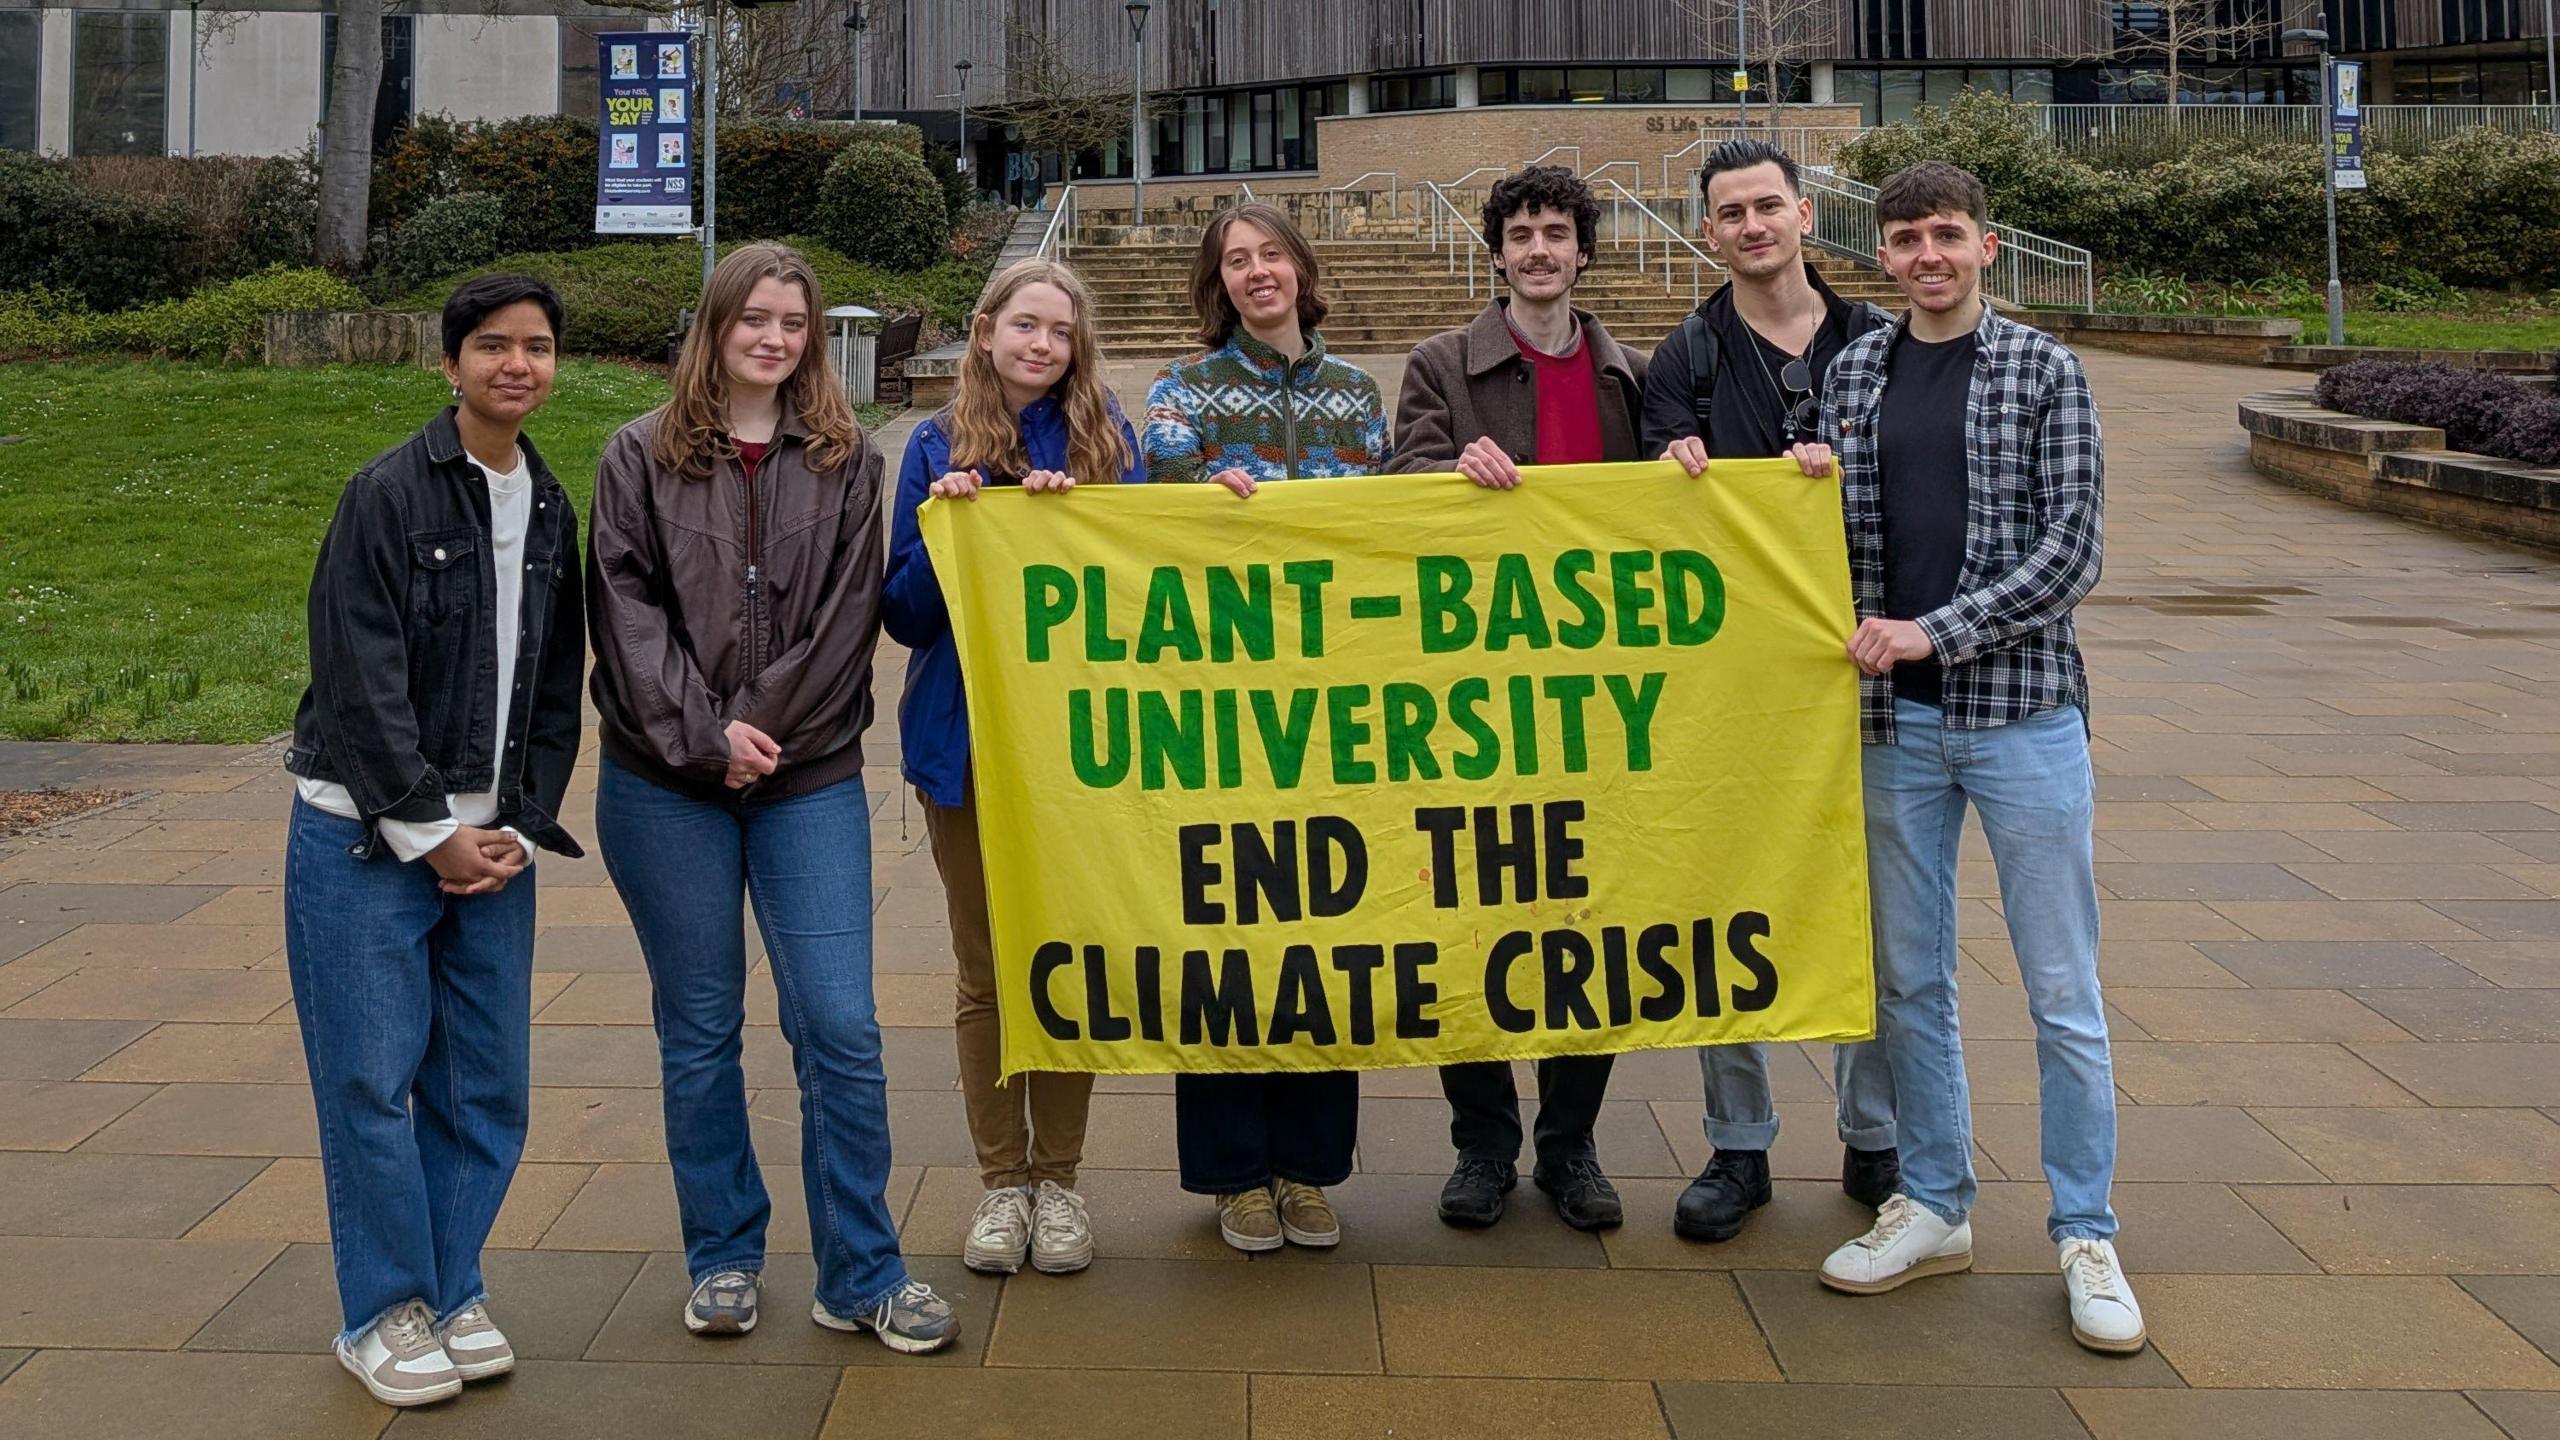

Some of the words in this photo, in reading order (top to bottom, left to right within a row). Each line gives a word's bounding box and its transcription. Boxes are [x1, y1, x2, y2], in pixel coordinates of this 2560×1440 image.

[613, 88, 631, 96] Your
[606, 97, 654, 111] YOUR
[610, 112, 640, 126] SAY
[1671, 116, 1697, 132] Life
[1704, 116, 1764, 128] Scienes
[2336, 133, 2353, 144] YOUR
[667, 178, 683, 190] NSS
[1022, 548, 1726, 665] PLANT-BASED
[1068, 671, 1668, 791] UNIVERSITY
[1178, 815, 1369, 926] END
[1414, 799, 1589, 909] THE
[1029, 941, 1441, 1048] CLIMATE
[1484, 910, 1780, 1034] CRISIS
